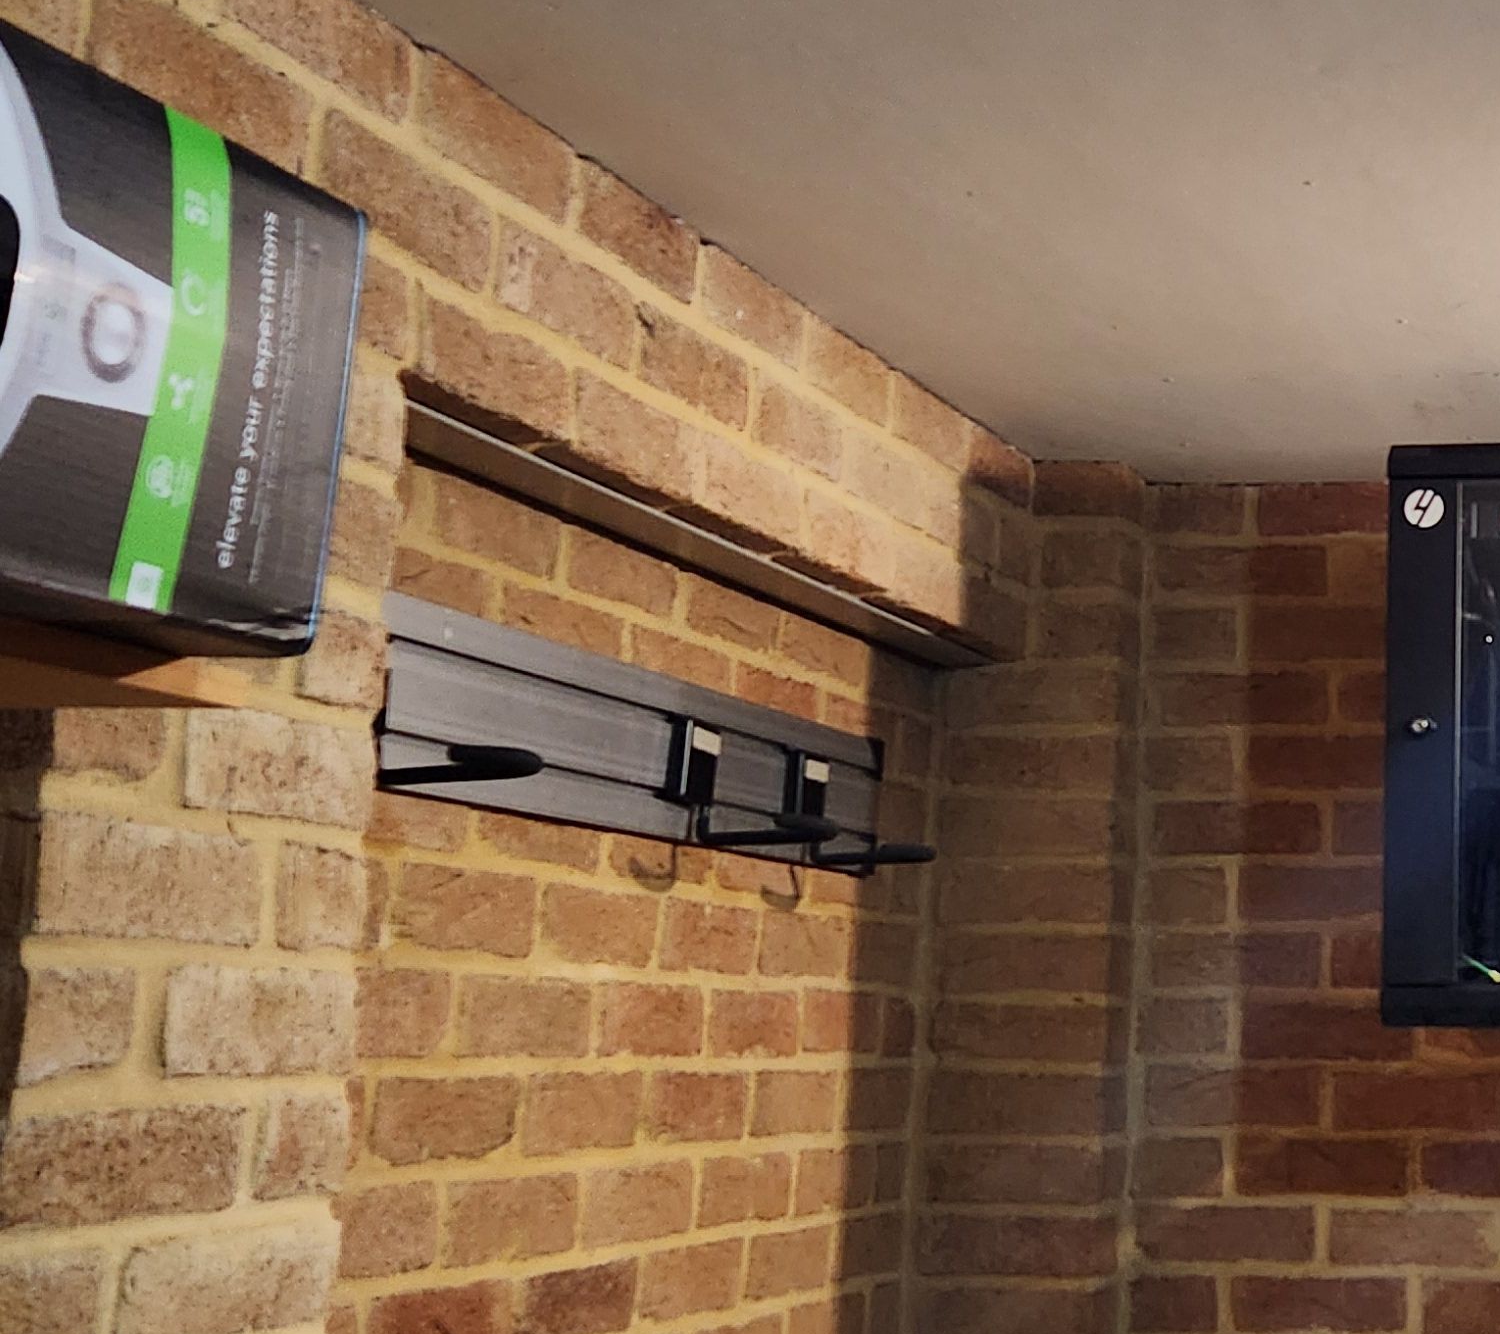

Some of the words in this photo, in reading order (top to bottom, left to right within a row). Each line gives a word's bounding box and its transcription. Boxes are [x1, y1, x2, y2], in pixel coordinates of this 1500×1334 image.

[216, 467, 250, 569] elevate
[239, 395, 263, 460] your
[251, 210, 279, 389] expectations
